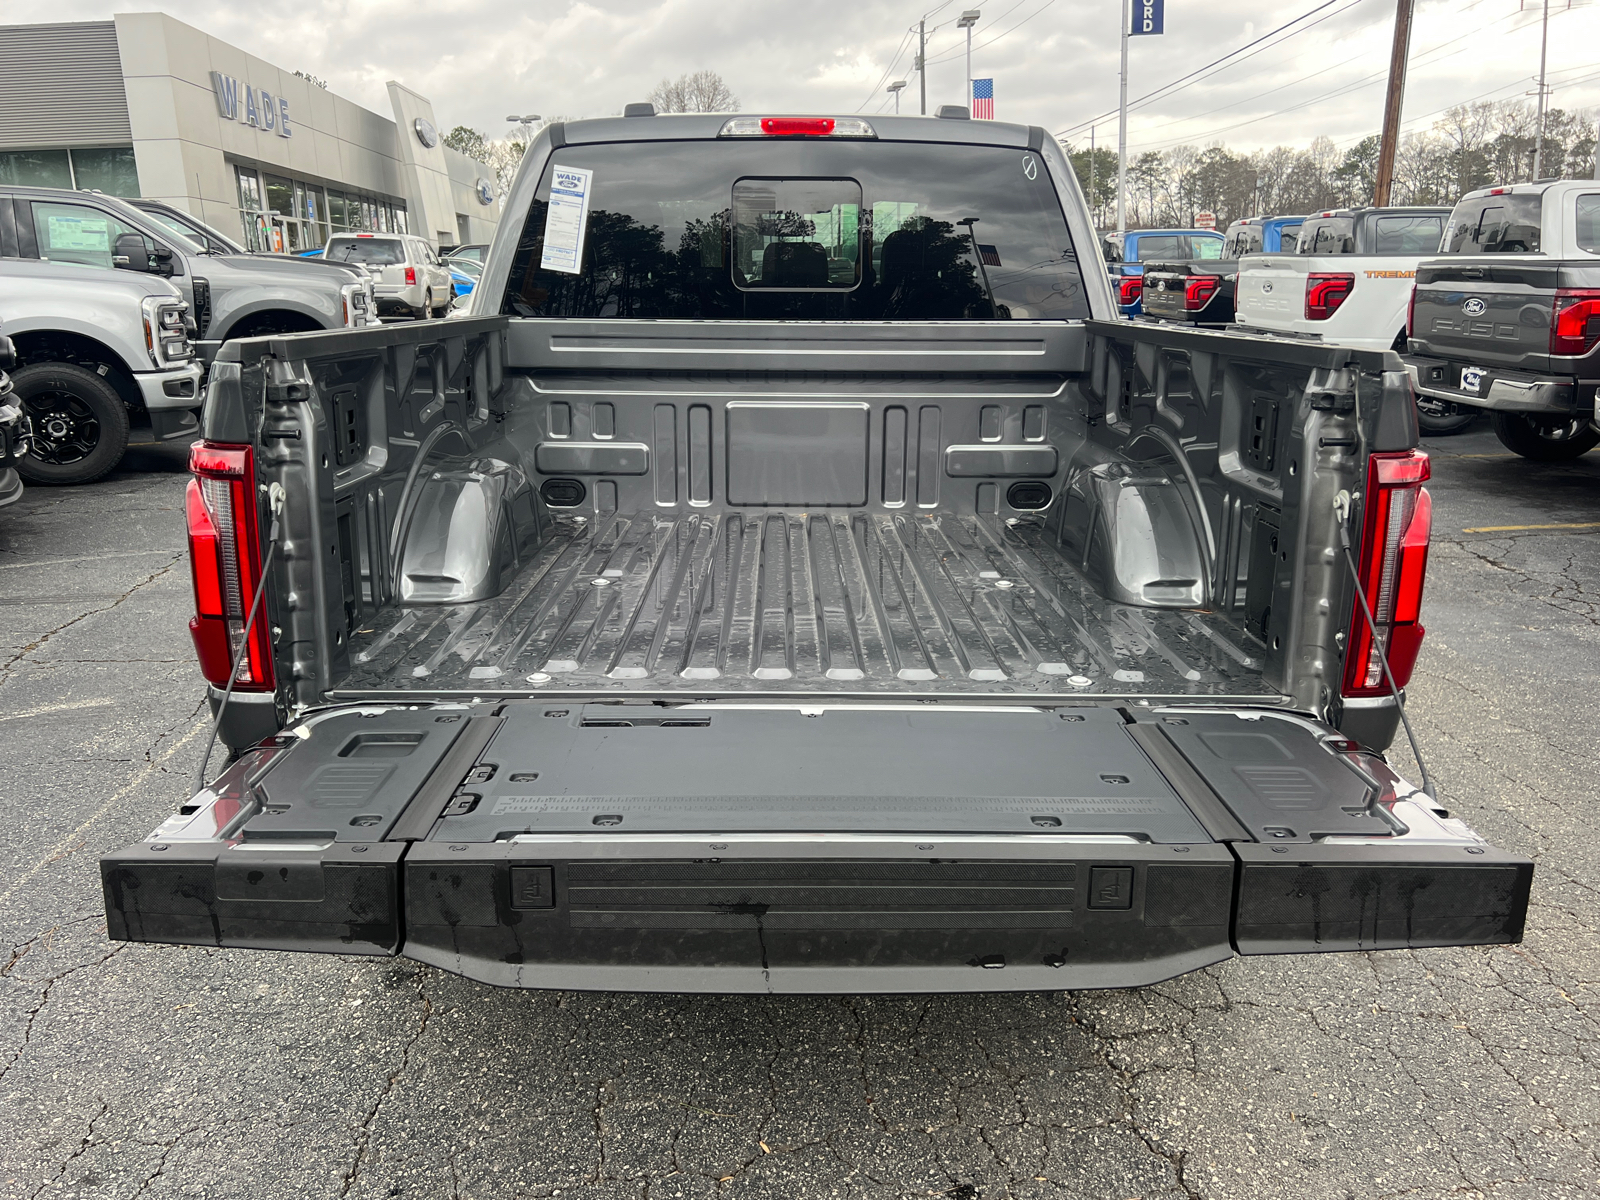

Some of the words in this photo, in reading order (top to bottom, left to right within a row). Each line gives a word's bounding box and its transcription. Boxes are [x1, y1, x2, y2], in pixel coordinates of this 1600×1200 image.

[210, 71, 292, 138] WADE
[556, 173, 582, 183] WADE
[1431, 317, 1520, 340] F-150
